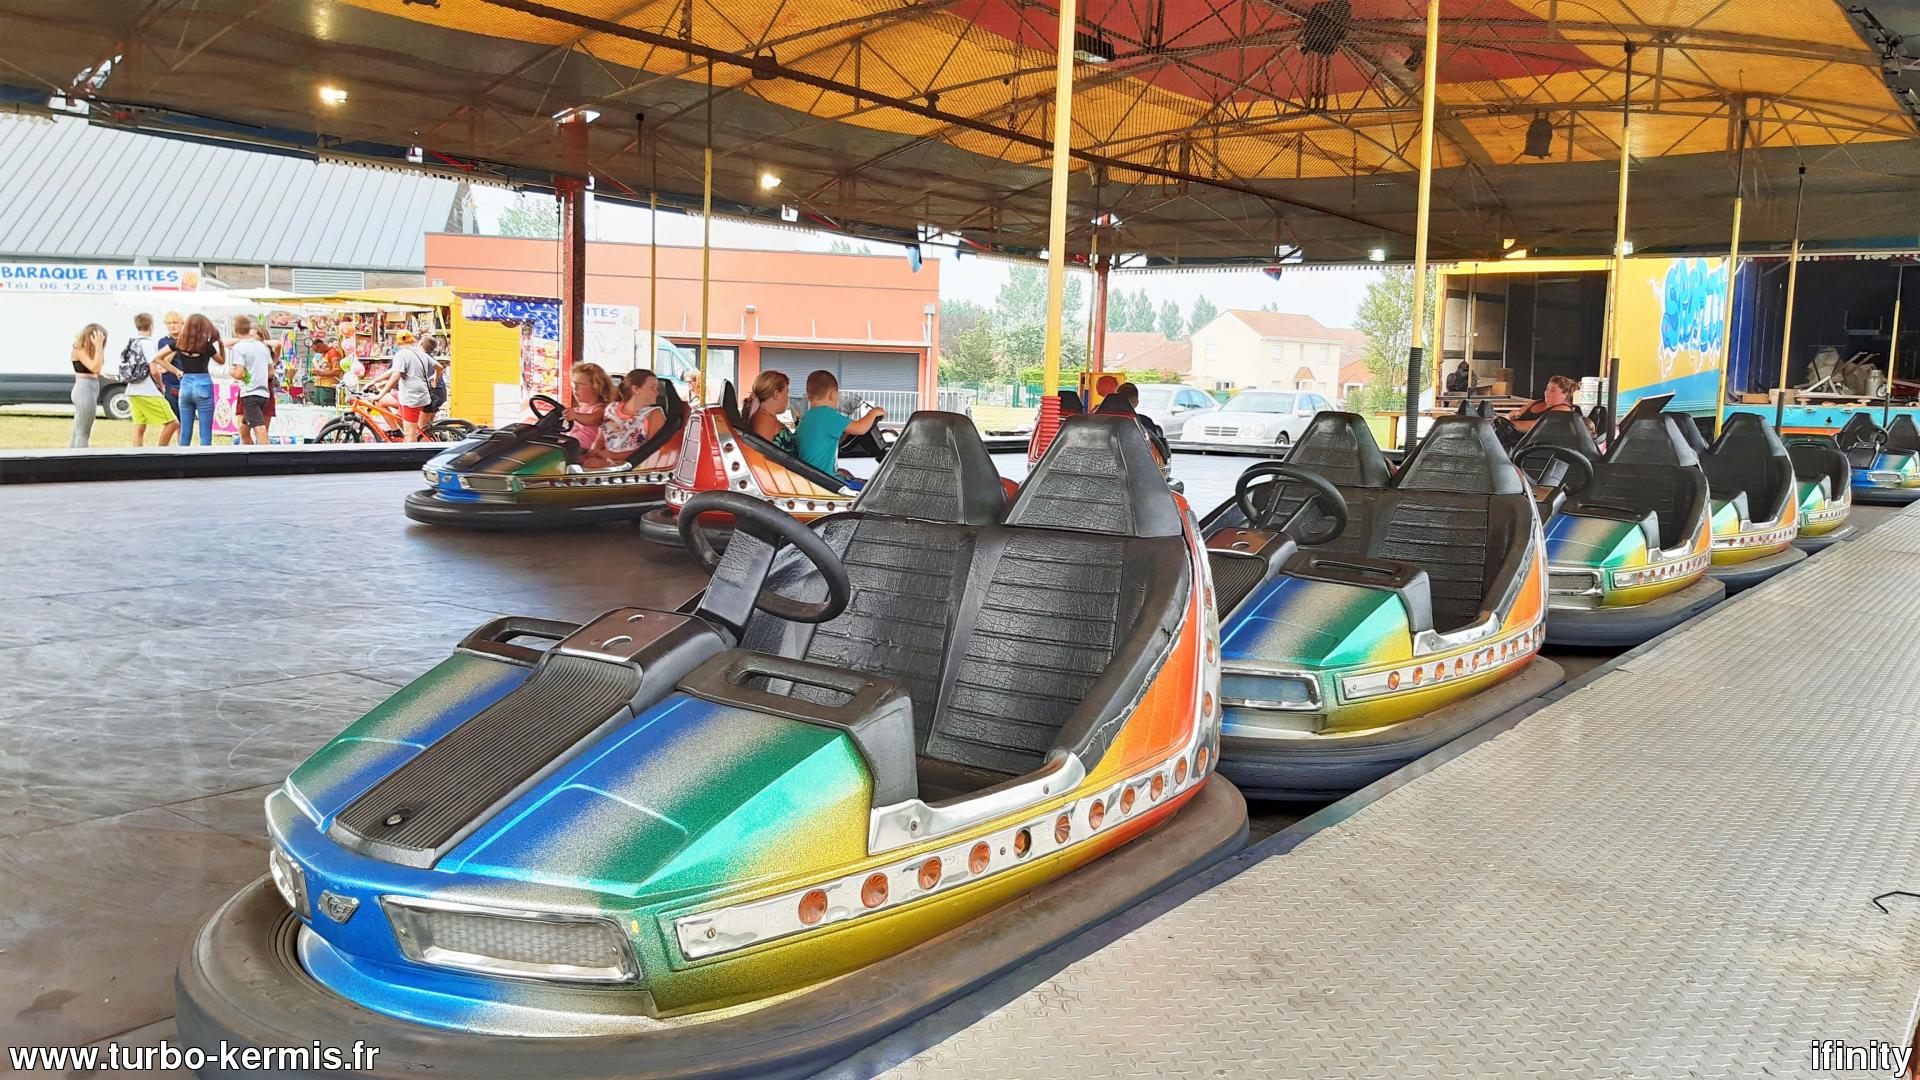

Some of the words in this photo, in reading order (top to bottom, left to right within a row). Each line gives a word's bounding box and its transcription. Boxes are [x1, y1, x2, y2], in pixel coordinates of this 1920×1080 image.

[2, 267, 88, 279] BARAQUE
[116, 269, 178, 281] FRITES
[586, 307, 619, 318] ITES
